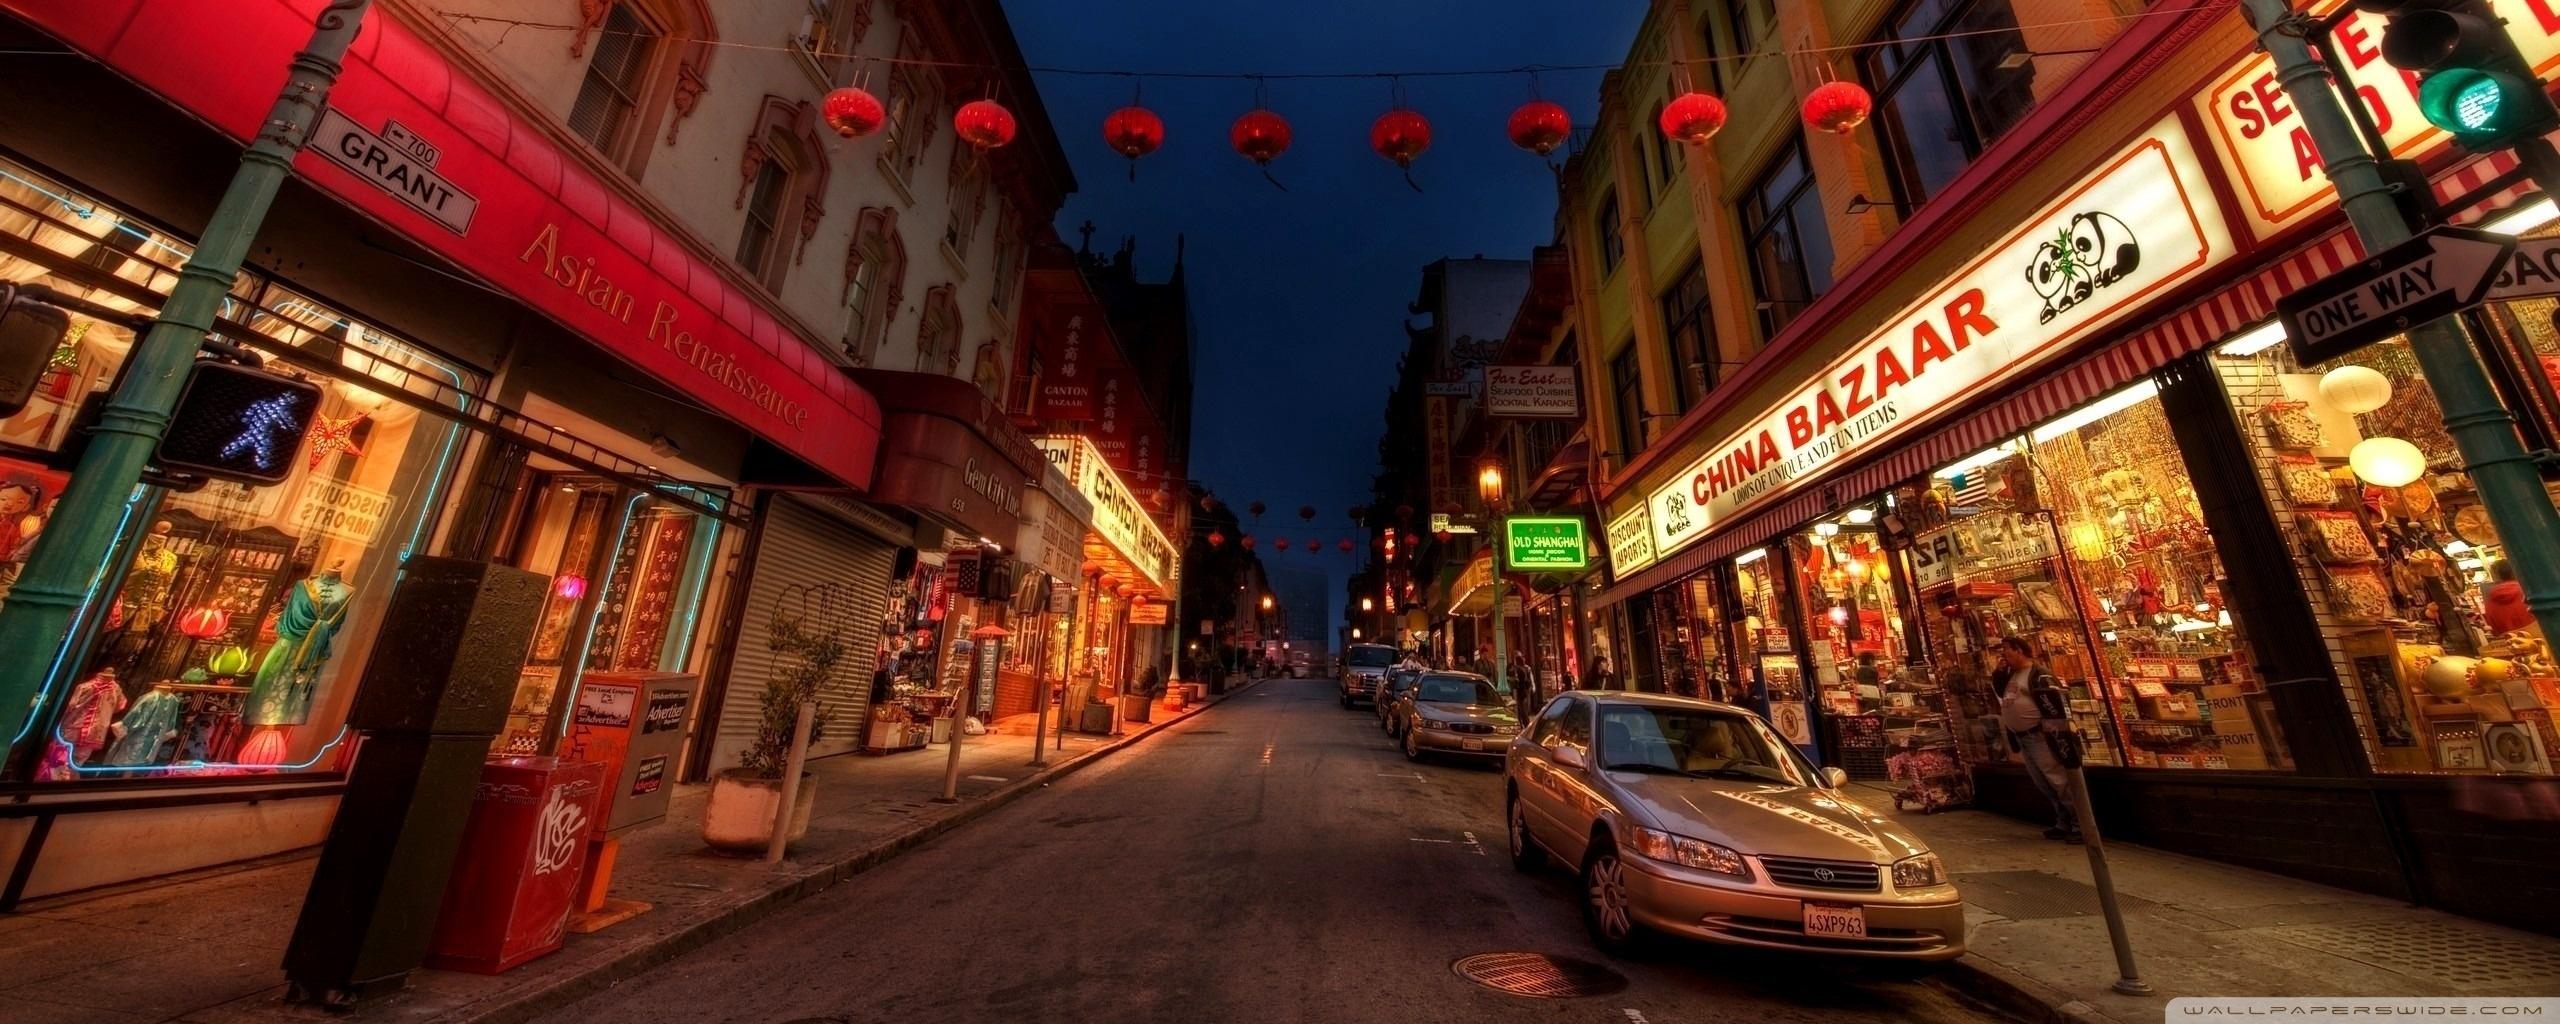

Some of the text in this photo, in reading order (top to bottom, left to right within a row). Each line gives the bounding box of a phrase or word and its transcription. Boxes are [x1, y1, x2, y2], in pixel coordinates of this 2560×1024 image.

[408, 136, 435, 163] 700
[340, 132, 453, 211] GRANT
[2305, 259, 2437, 338] ONE WAY
[520, 223, 808, 432] Asian Renaissance
[1489, 369, 1518, 384] Far
[1518, 369, 1555, 385] East
[1045, 386, 1088, 396] CANTON
[1489, 397, 1575, 408] COCKTAIL KARAOKE
[1490, 386, 1574, 396] SEAFOOD CUISINE
[1692, 288, 1999, 506] CHINA BAZAAR
[1048, 399, 1082, 407] BAZAAR
[1755, 473, 1768, 494] OF
[1768, 453, 1806, 487] UNIQUE
[1807, 440, 1829, 467] AND
[1829, 426, 1855, 454] FUN
[1856, 401, 1898, 439] ITEMS
[964, 457, 1020, 518] Gem City Inc.
[1094, 468, 1140, 536] CANTON
[1514, 536, 1579, 548] OLD SHANGHAI
[1610, 512, 1646, 549] DISCOUNT
[1615, 536, 1648, 570] IMPORTS
[647, 704, 685, 721] Advertiser
[2207, 696, 2244, 709] FRONT
[2219, 733, 2256, 745] FRONT
[1809, 914, 1862, 934] 4SXP963
